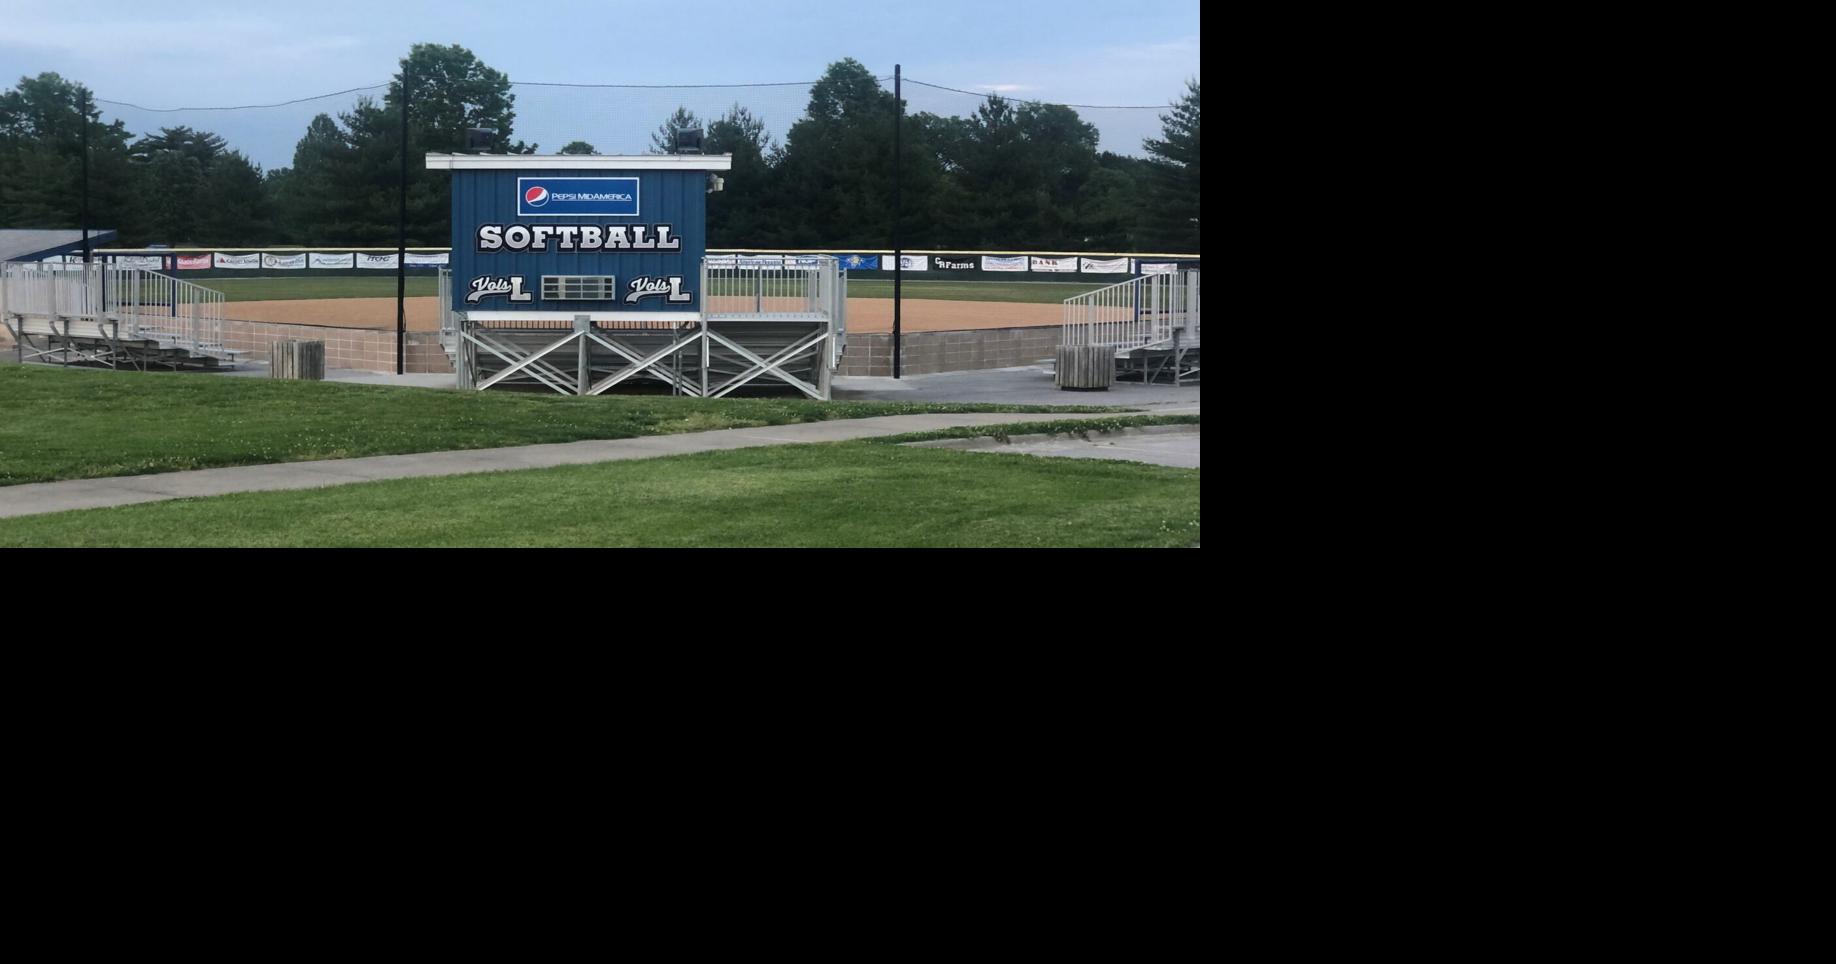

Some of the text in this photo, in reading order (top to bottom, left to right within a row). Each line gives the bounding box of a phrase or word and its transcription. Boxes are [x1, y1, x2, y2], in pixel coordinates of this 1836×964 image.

[479, 225, 680, 249] SOFTBALL
[469, 276, 532, 301] Vols L
[629, 276, 691, 301] Vols L
